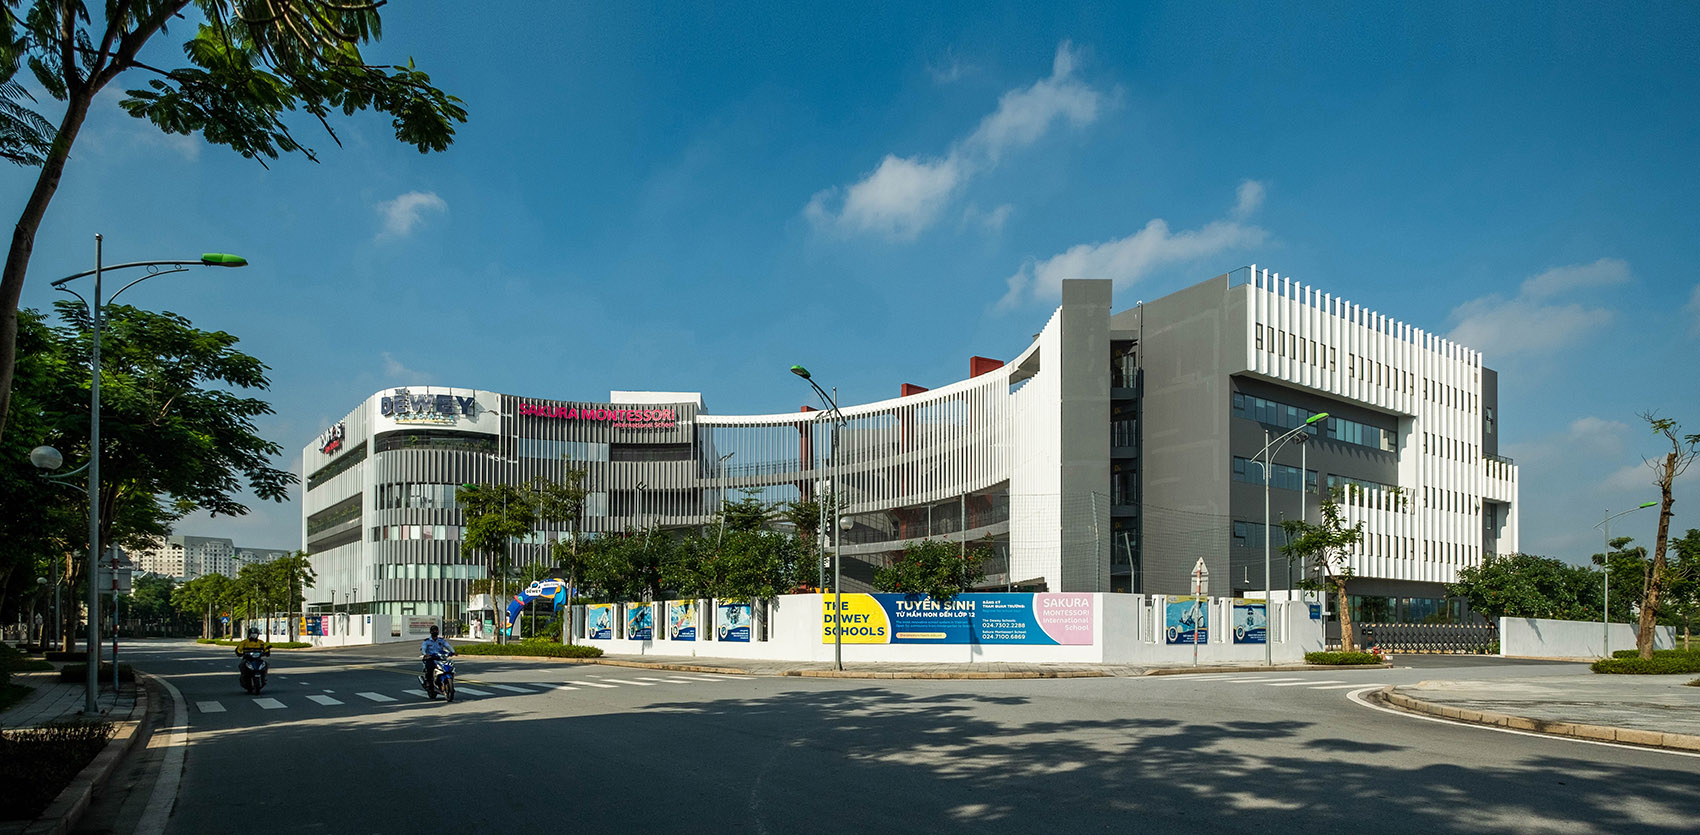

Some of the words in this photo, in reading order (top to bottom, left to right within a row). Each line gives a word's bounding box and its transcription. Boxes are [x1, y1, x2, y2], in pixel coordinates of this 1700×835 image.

[381, 394, 475, 416] DEWEY
[519, 403, 578, 420] SAKURA
[582, 408, 675, 421] MONTESSORI
[896, 596, 940, 610] TUYỂN
[943, 601, 976, 611] SINH
[1043, 598, 1089, 607] SAKURA
